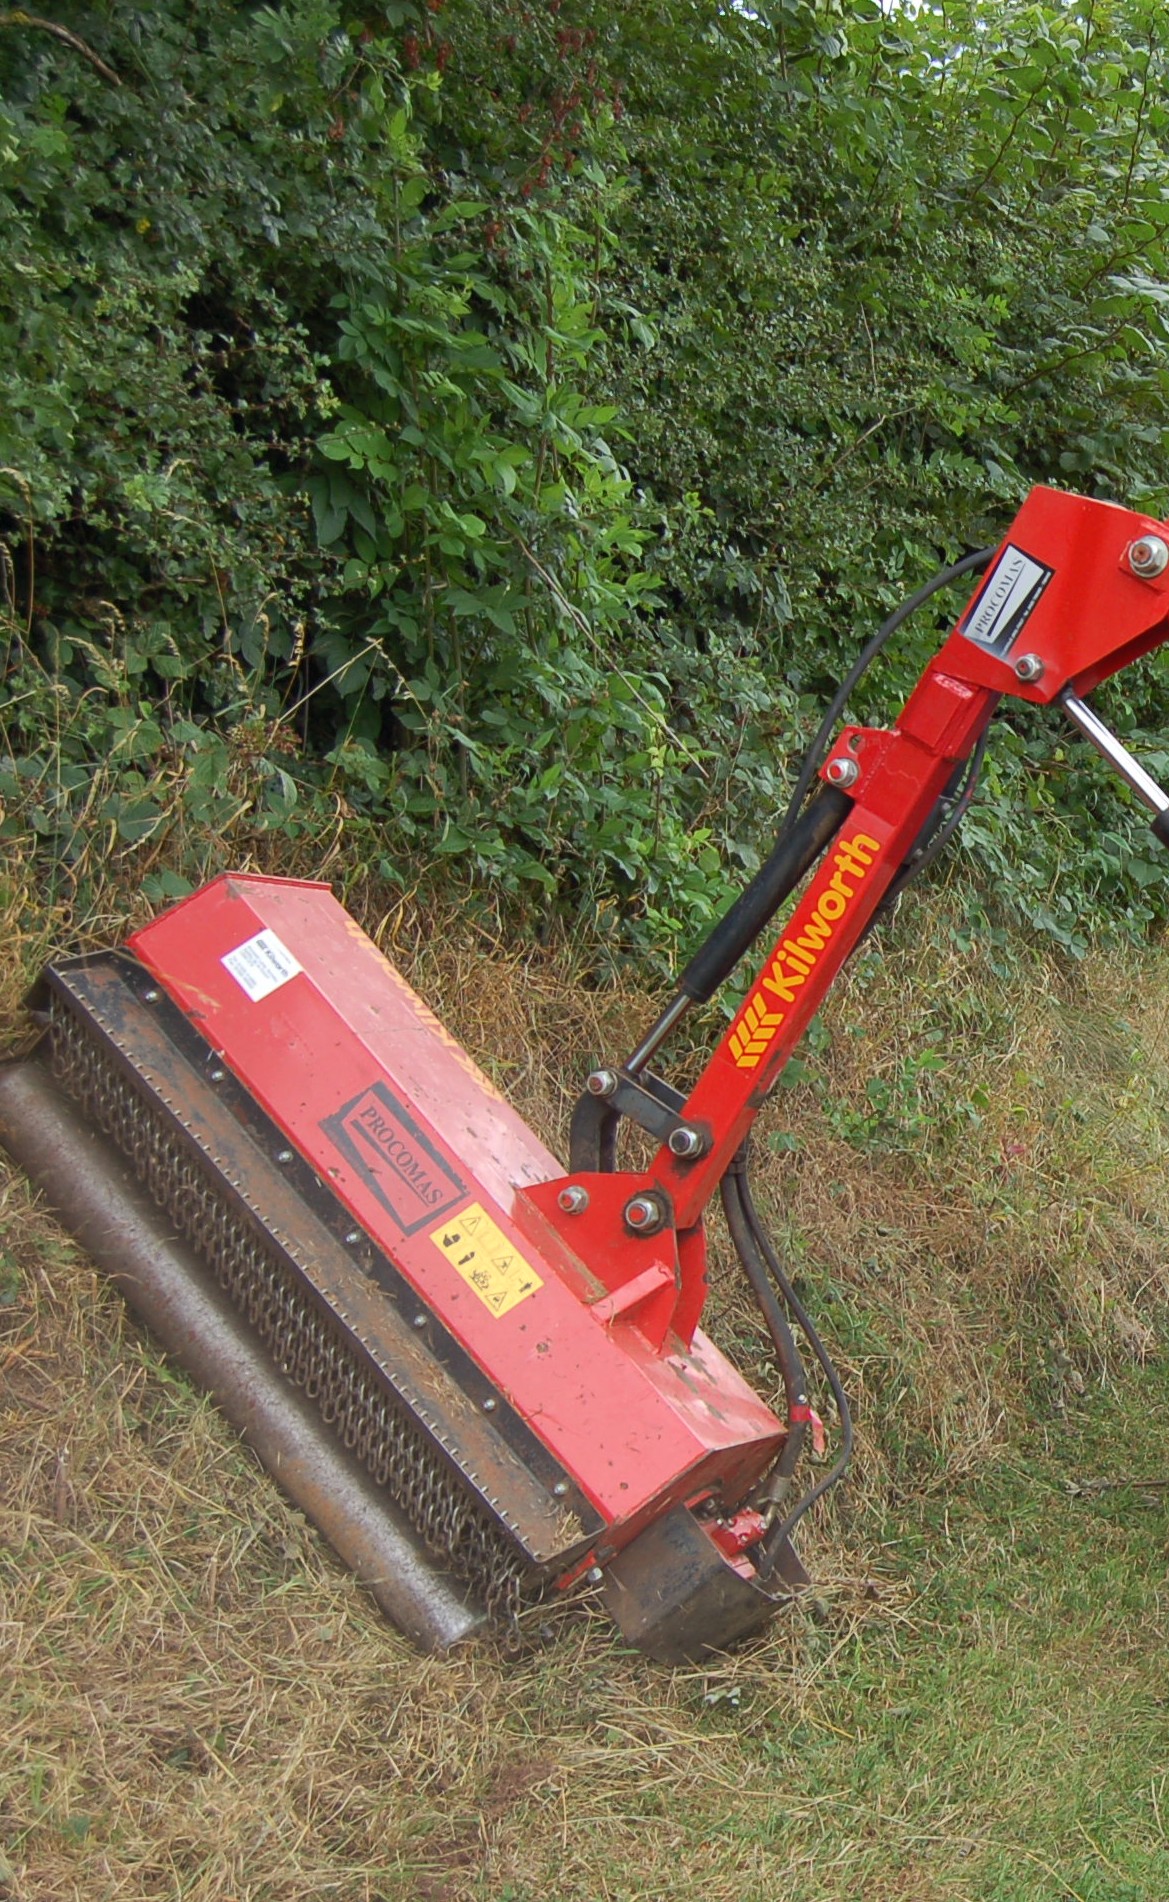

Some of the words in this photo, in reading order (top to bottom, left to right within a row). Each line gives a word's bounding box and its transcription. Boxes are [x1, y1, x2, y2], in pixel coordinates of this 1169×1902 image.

[974, 559, 1023, 635] PROCOMAS
[762, 833, 881, 1003] Kilworth
[360, 1105, 444, 1205] PROCOMAS
